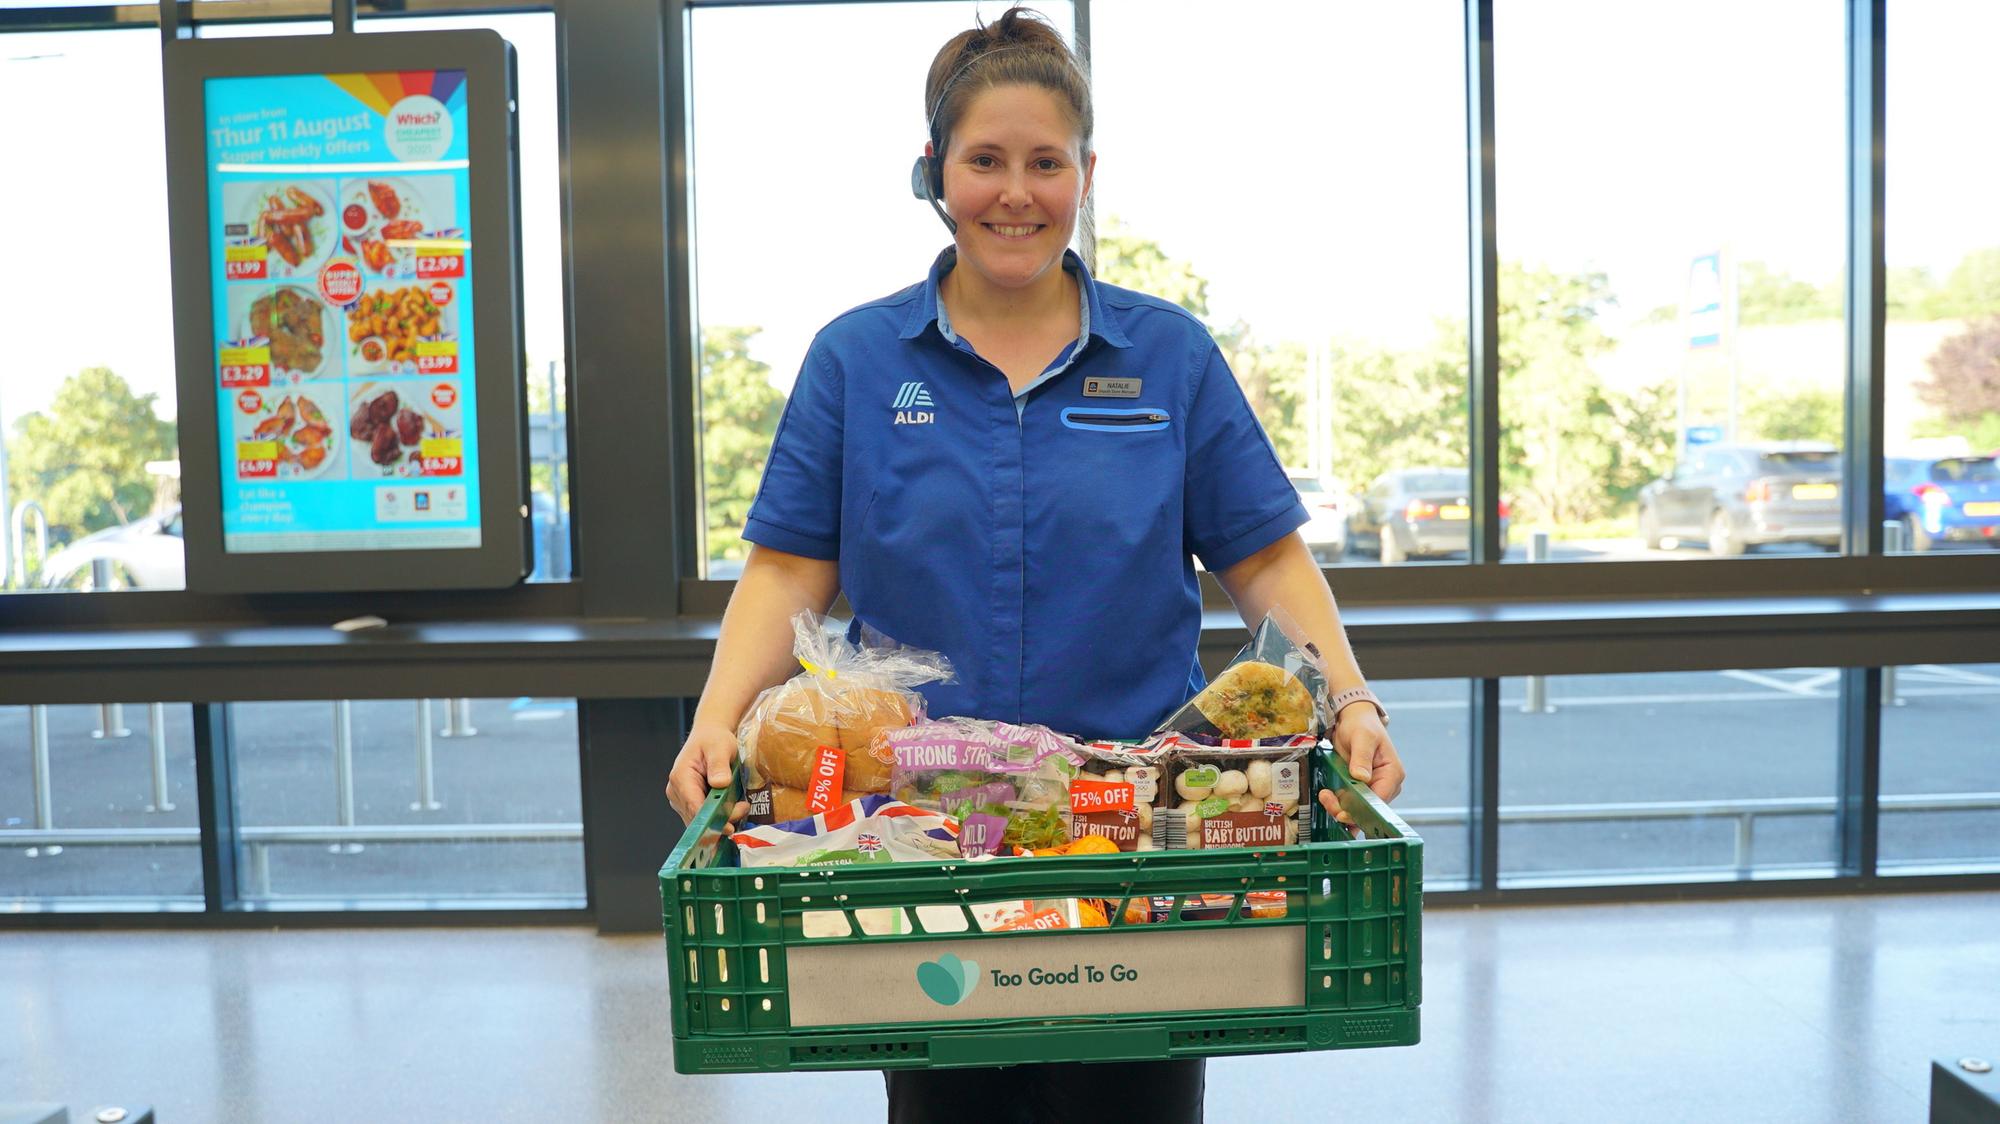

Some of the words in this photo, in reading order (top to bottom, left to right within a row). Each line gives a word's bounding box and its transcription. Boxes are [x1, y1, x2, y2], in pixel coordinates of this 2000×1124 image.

[397, 111, 442, 126] Which?
[211, 128, 262, 148] Thur
[267, 121, 287, 141] 11
[294, 112, 371, 138] August
[221, 150, 264, 163] Super
[268, 144, 321, 159] Weekly
[418, 256, 459, 273] £2.99
[894, 411, 935, 425] ALDI
[819, 749, 839, 778] OFF
[894, 744, 957, 768] STRONG
[811, 780, 832, 811] 75%
[1071, 792, 1102, 808] 75%
[1103, 788, 1129, 804] OFF
[1073, 822, 1088, 837] BY
[1089, 824, 1136, 840] BUTTON
[1204, 820, 1233, 828] BRITISH
[1204, 828, 1234, 844] BABY
[1235, 825, 1282, 842] BUTTON
[1034, 912, 1061, 930] OFF
[990, 969, 1023, 987] Too
[1028, 965, 1079, 986] Good
[1084, 965, 1105, 983] To
[1110, 964, 1138, 982] Go
